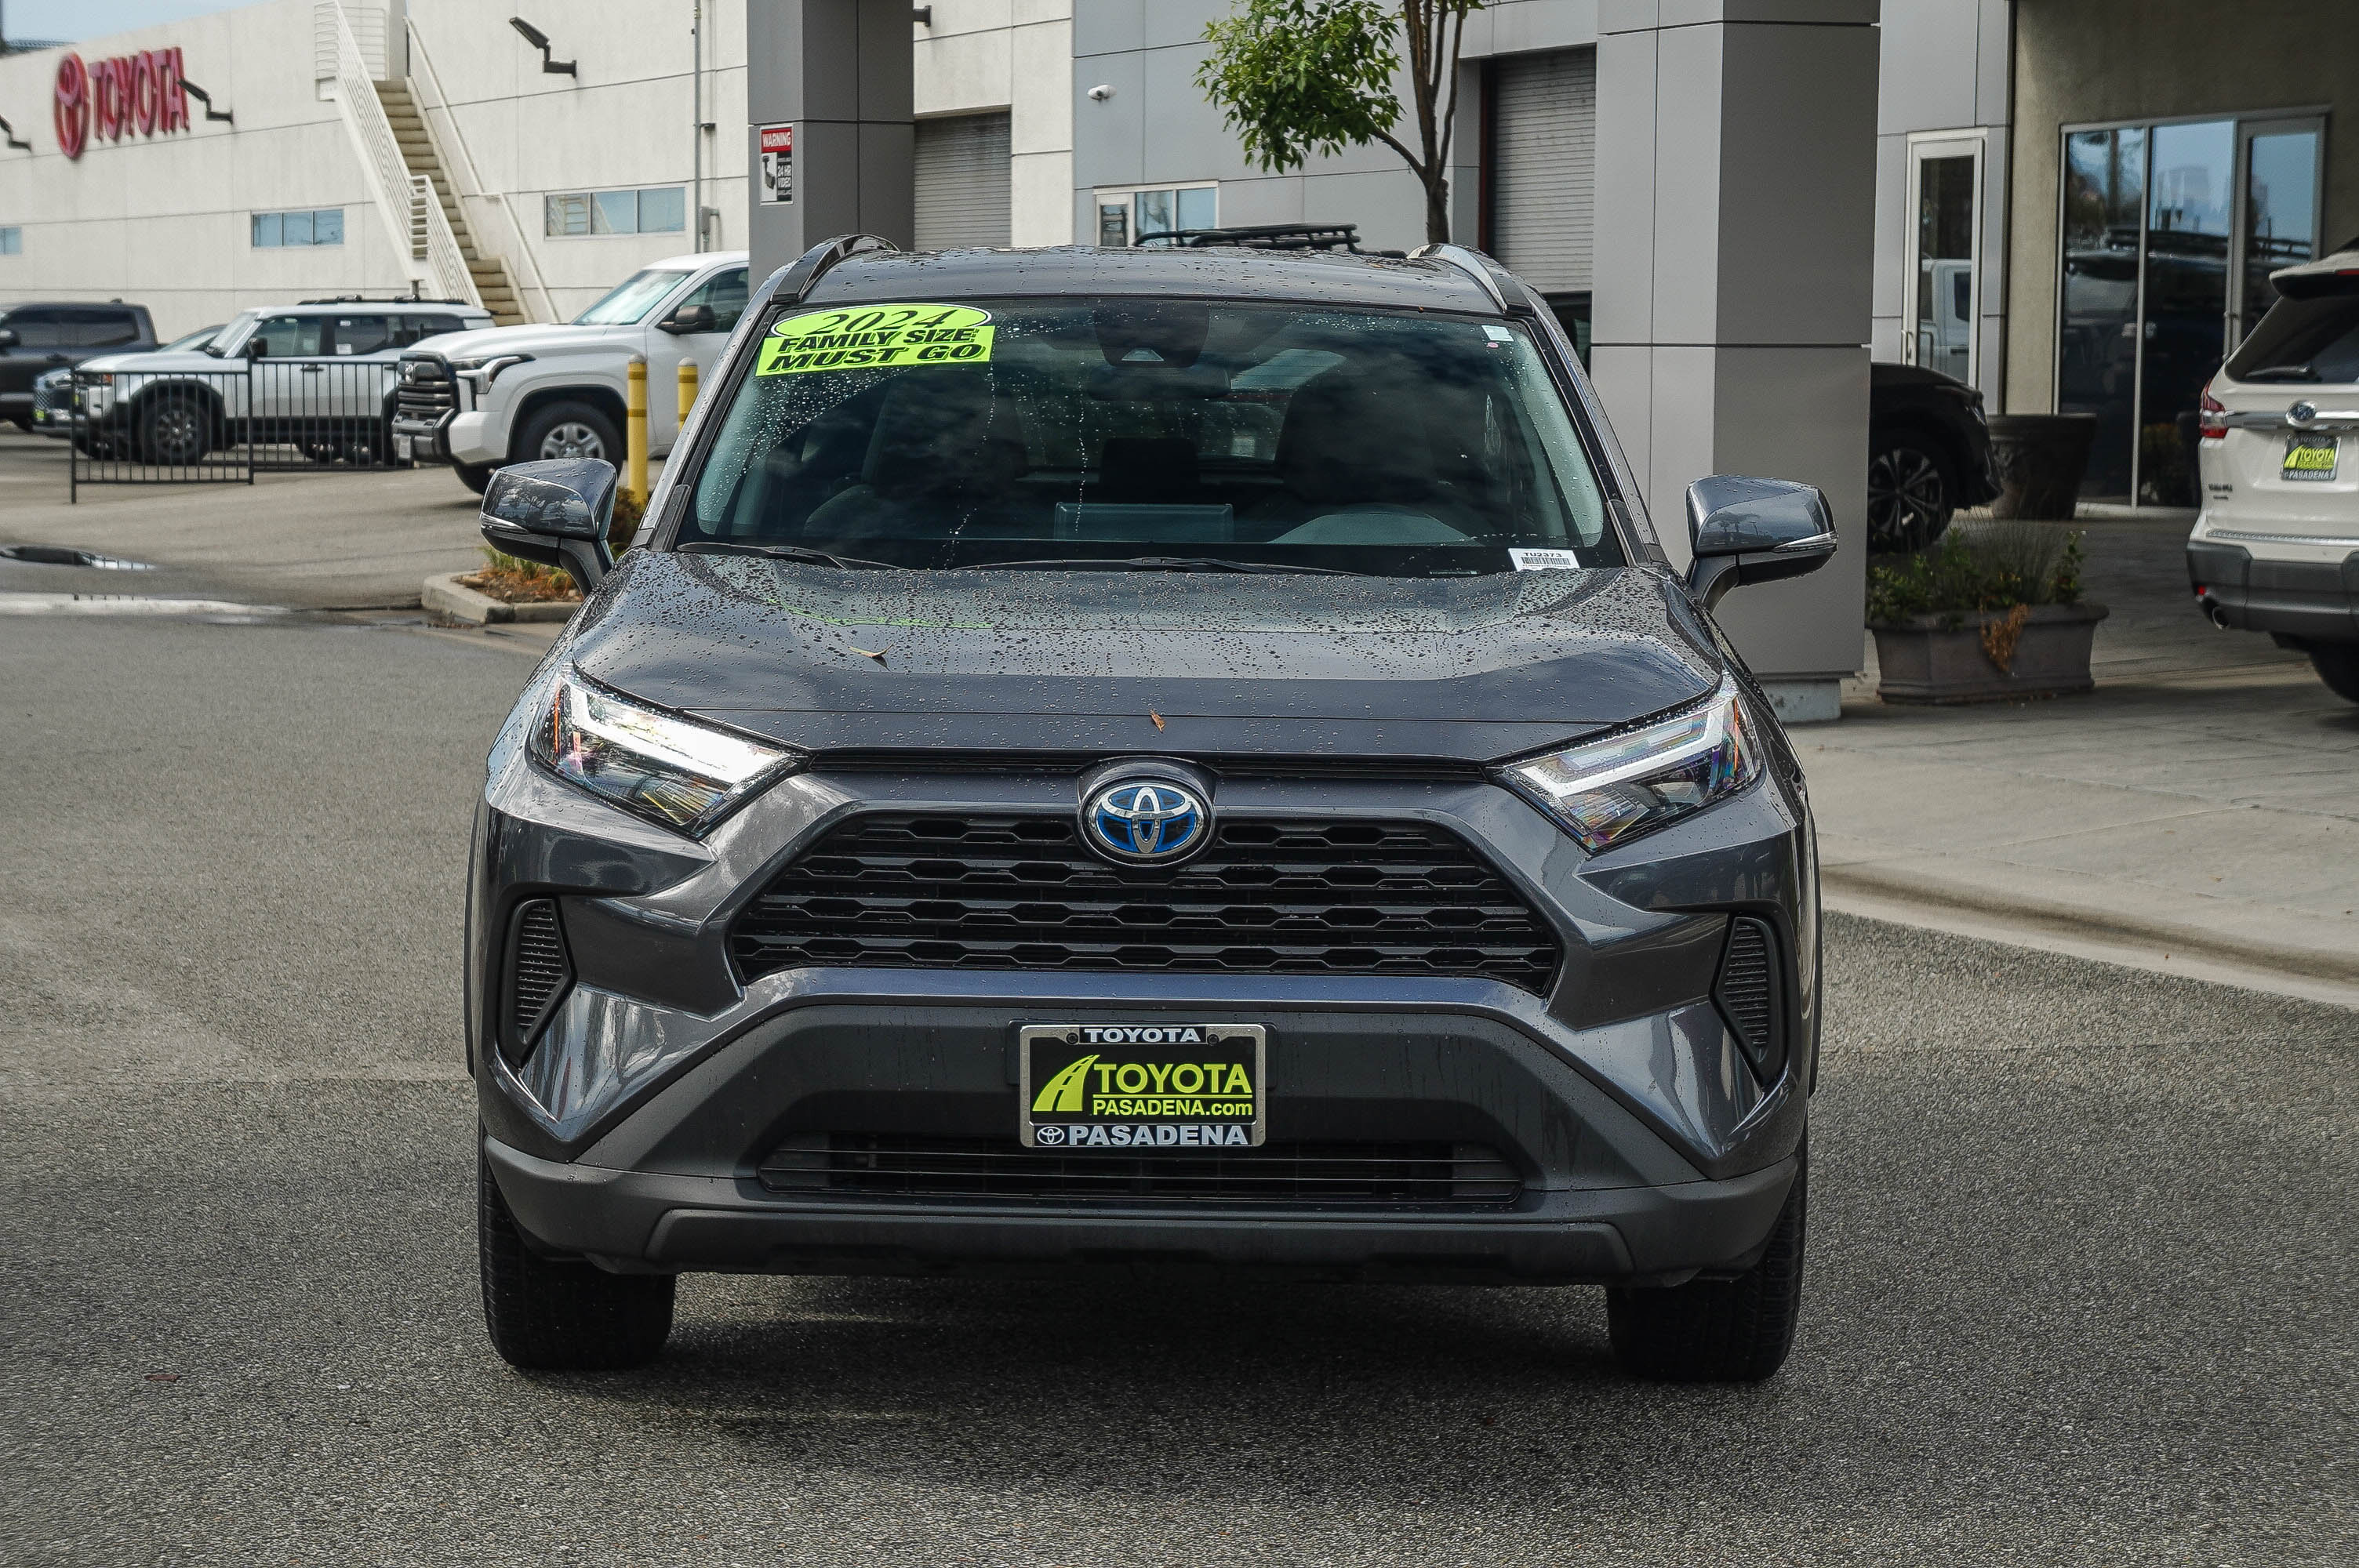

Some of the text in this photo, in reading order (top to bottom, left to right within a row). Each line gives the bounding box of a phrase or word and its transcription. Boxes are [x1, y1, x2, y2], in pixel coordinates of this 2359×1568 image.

[88, 47, 190, 140] TOYOTA
[762, 131, 791, 147] WARNING
[805, 309, 958, 334] 2024
[777, 328, 980, 353] FAMILY SIZE
[765, 343, 986, 372] MUST GO
[2299, 448, 2335, 462] TOYOTA
[1084, 1028, 1201, 1043] TOYOTA
[1094, 1063, 1252, 1094] TOYOTA
[1093, 1099, 1252, 1116] PASADENA.com
[1069, 1126, 1249, 1145] PASADENA
